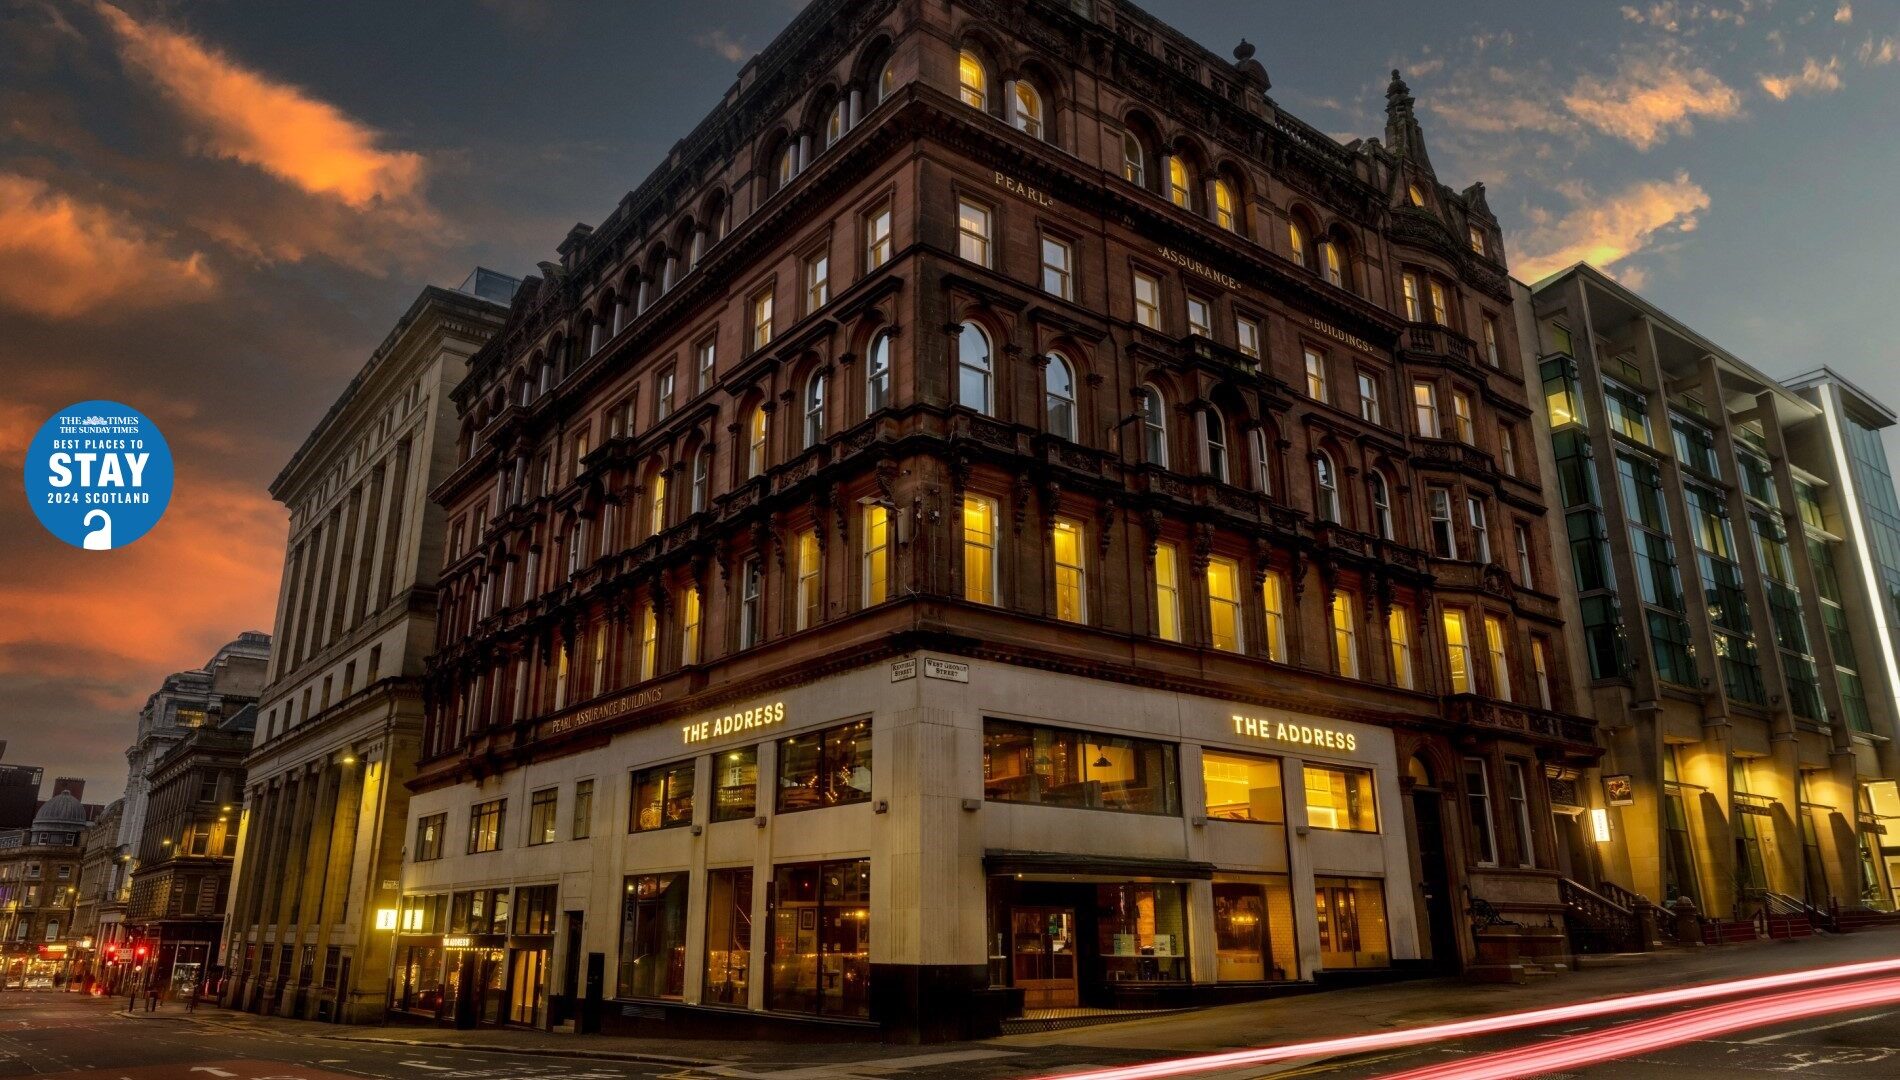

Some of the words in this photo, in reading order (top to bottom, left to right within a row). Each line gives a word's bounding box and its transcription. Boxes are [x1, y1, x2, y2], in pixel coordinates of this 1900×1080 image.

[995, 171, 1048, 206] PEARL
[1162, 247, 1236, 289] ASSURANCE
[1314, 319, 1369, 351] BUILDINGS
[926, 660, 943, 668] WEST
[936, 668, 959, 677] STREET
[552, 717, 571, 733] PEARL
[575, 701, 618, 727] ASSURANCE
[620, 688, 662, 712] BUILDINGS
[683, 722, 709, 744] THE
[713, 702, 784, 737] ADDRESS
[1232, 715, 1270, 738] THE
[1277, 722, 1356, 751] ADDRESS
